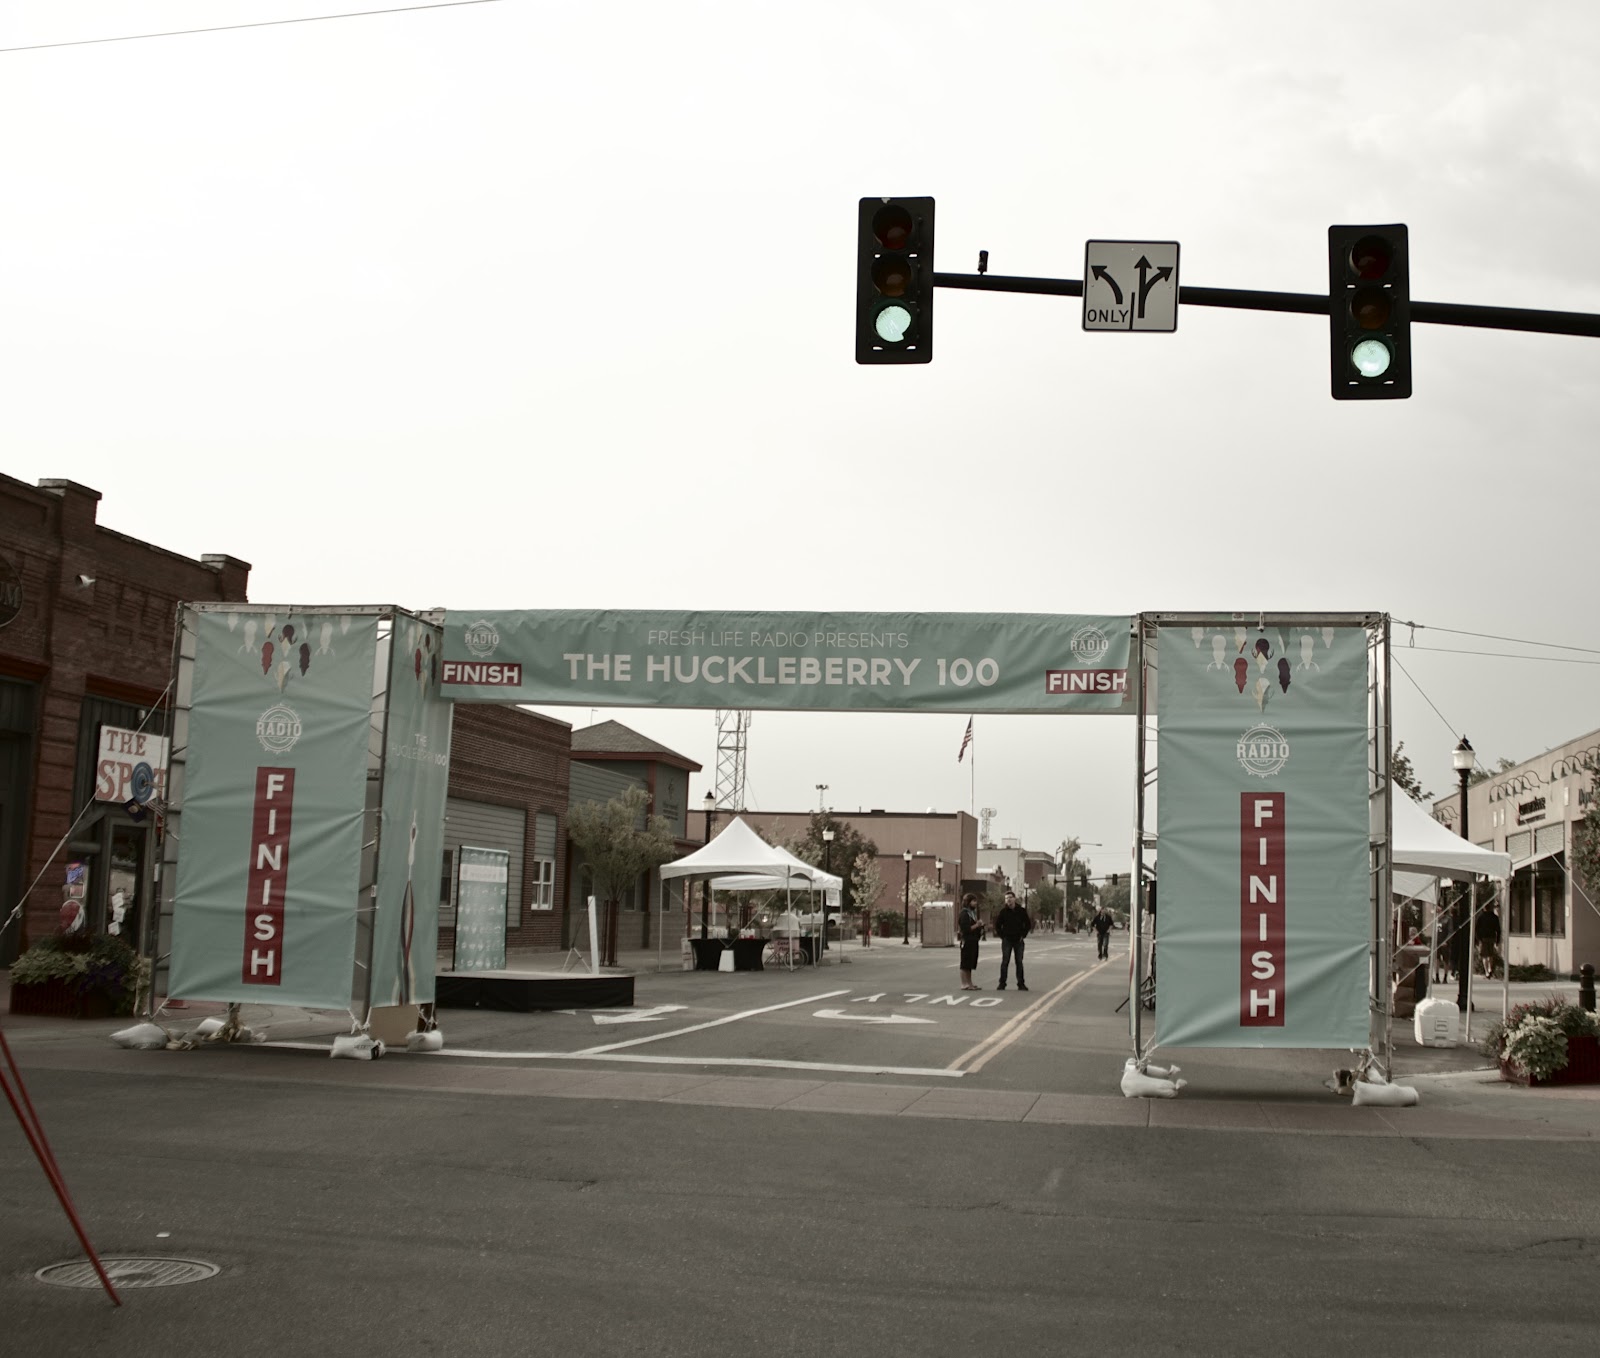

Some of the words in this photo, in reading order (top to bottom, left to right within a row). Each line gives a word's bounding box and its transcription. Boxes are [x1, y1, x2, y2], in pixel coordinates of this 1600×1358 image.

[1087, 309, 1129, 323] ONLY
[464, 633, 500, 645] RADIO
[648, 630, 704, 646] FRESH
[711, 631, 743, 647] LIFE
[751, 632, 808, 648] RADIO
[814, 632, 909, 648] PRESENTS
[1070, 639, 1109, 651] RADIO
[442, 664, 519, 684] FINISH
[563, 653, 631, 681] THE
[646, 655, 921, 686] HUCKLEBERRY
[936, 657, 1000, 687] 100
[1049, 672, 1127, 692] FINISH
[256, 721, 302, 737] RADIO
[106, 729, 147, 757] THE
[1236, 743, 1290, 758] RADIO
[250, 774, 286, 977] FINISH
[1249, 799, 1277, 1017] FINISH
[849, 992, 1004, 1008] ONLY
